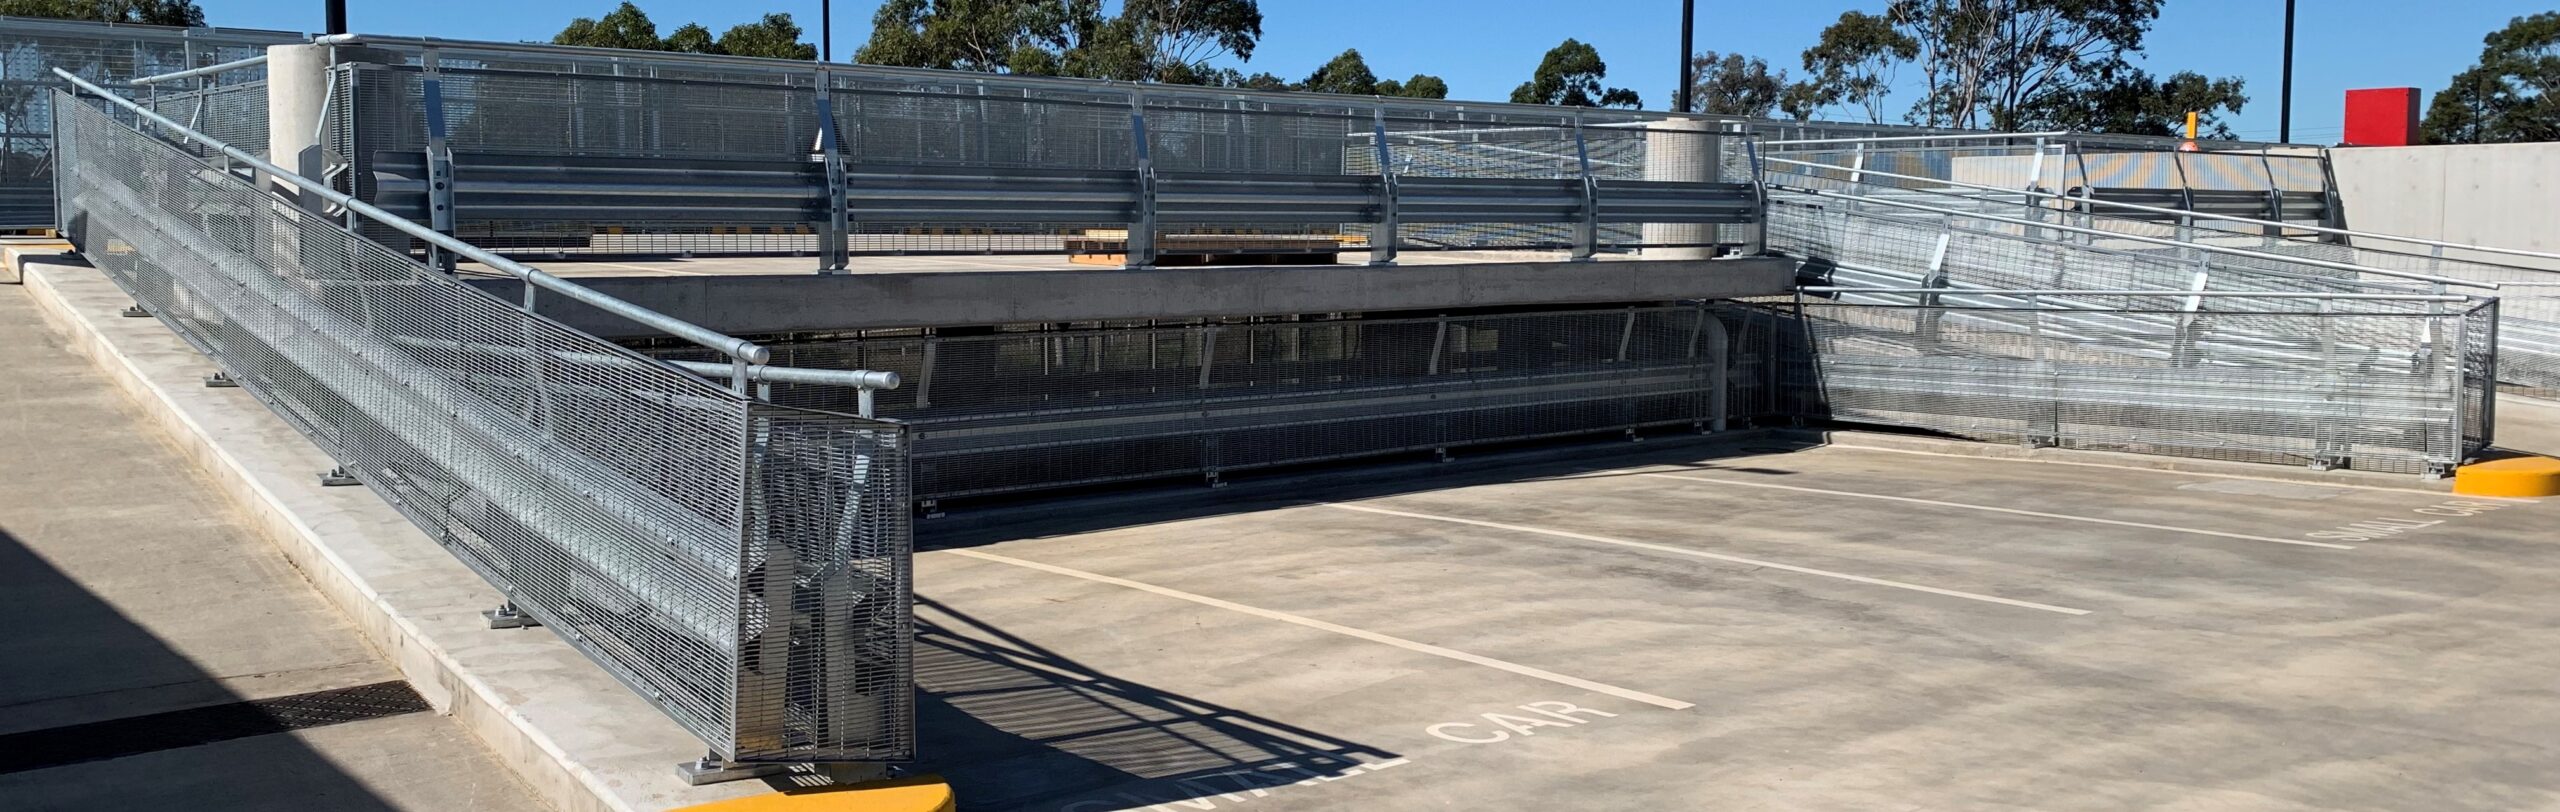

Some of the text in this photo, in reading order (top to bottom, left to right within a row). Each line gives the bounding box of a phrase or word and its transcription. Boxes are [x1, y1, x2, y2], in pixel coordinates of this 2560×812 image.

[2306, 500, 2510, 541] SMALL CAR
[1425, 701, 1619, 744] CAR
